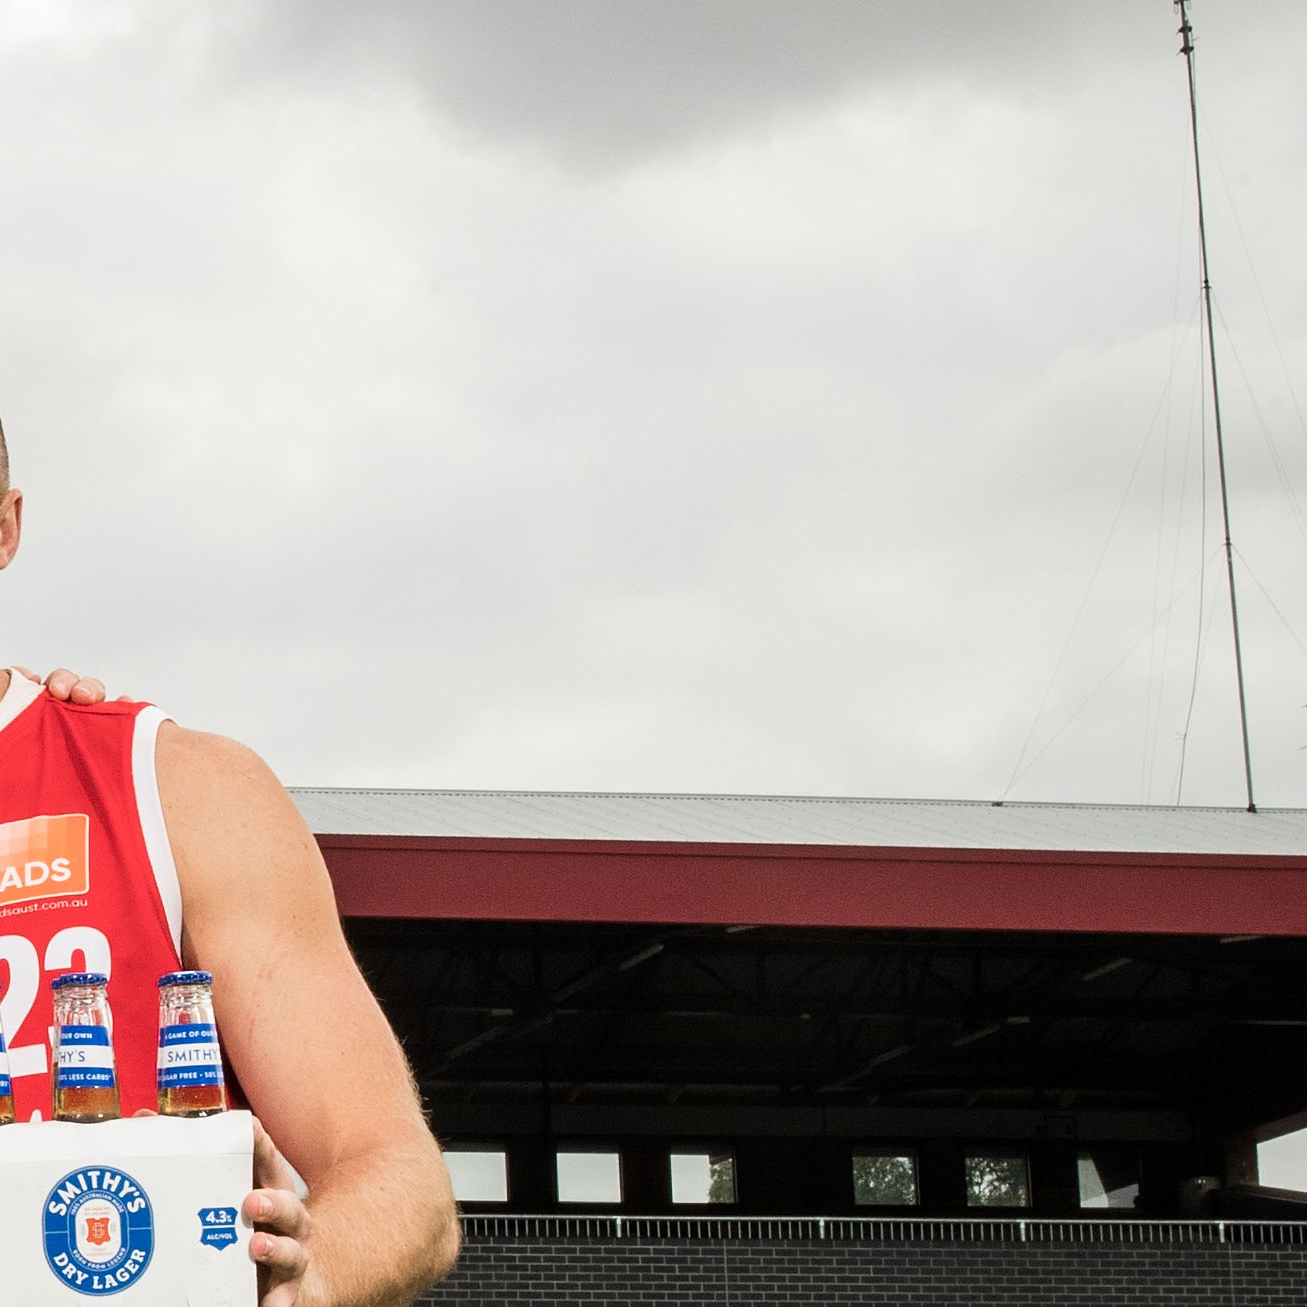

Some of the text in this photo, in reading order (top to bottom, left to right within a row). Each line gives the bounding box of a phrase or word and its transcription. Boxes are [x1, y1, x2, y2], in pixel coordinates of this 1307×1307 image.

[49, 1171, 146, 1217] SMITHY'S
[54, 1249, 146, 1289] DRY LAGER
